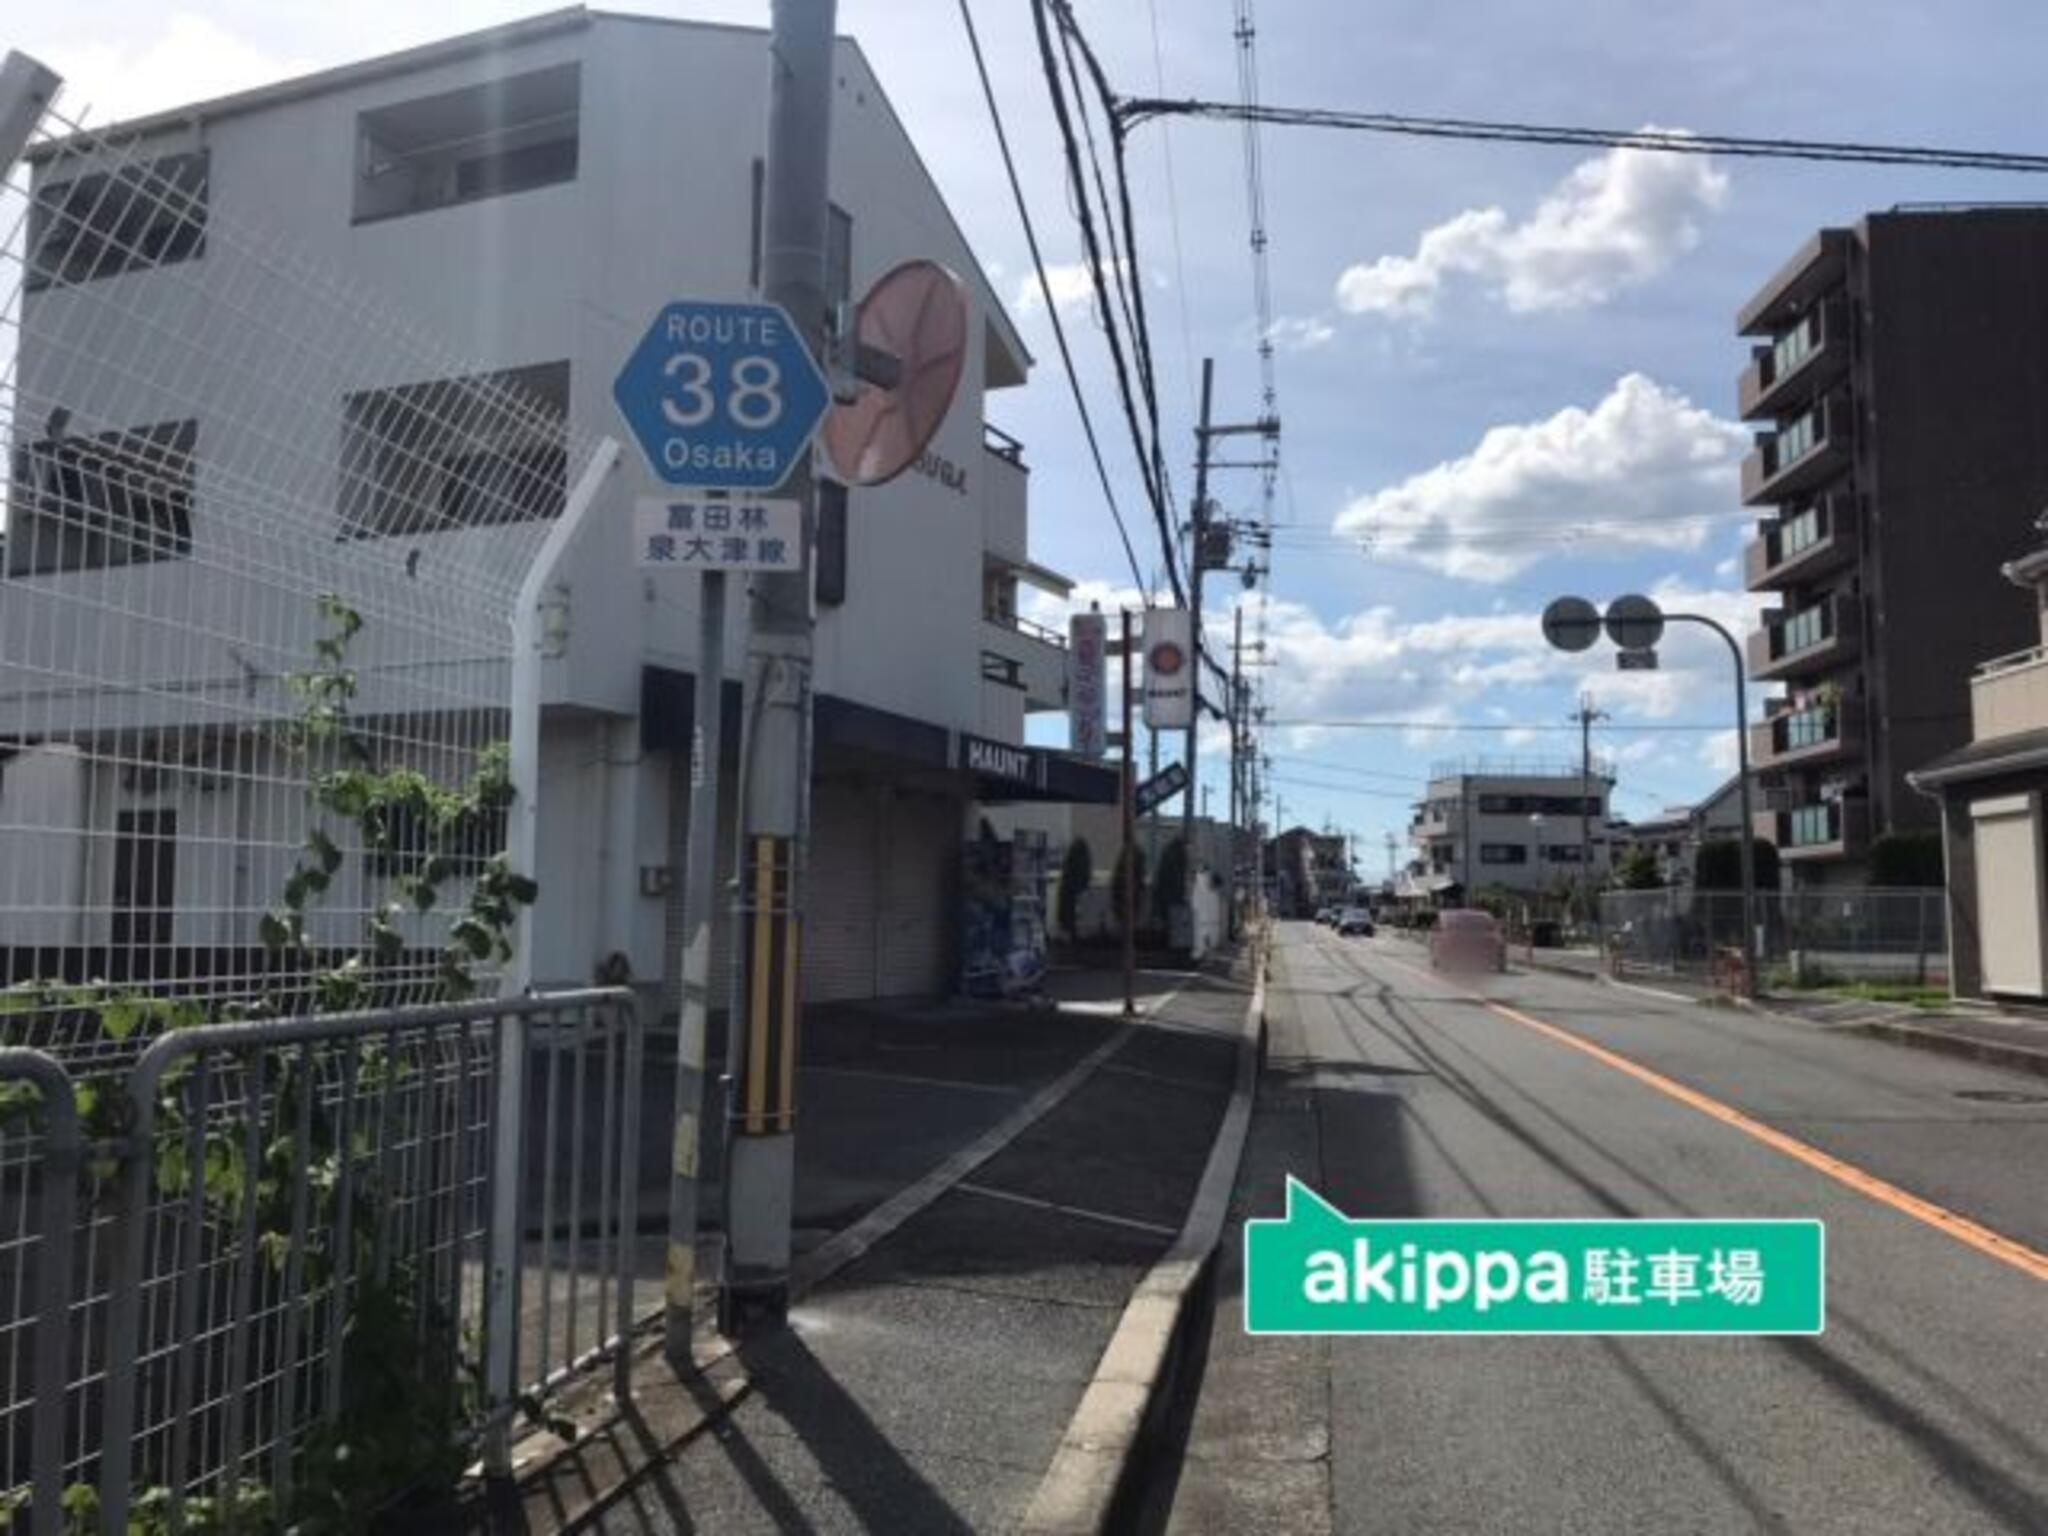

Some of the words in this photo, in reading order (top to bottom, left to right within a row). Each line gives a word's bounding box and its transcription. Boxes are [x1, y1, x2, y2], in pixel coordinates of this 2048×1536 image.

[667, 314, 779, 347] ROUTE
[661, 352, 782, 430] 38
[664, 436, 776, 470] Osaka
[667, 503, 769, 532] 富田林
